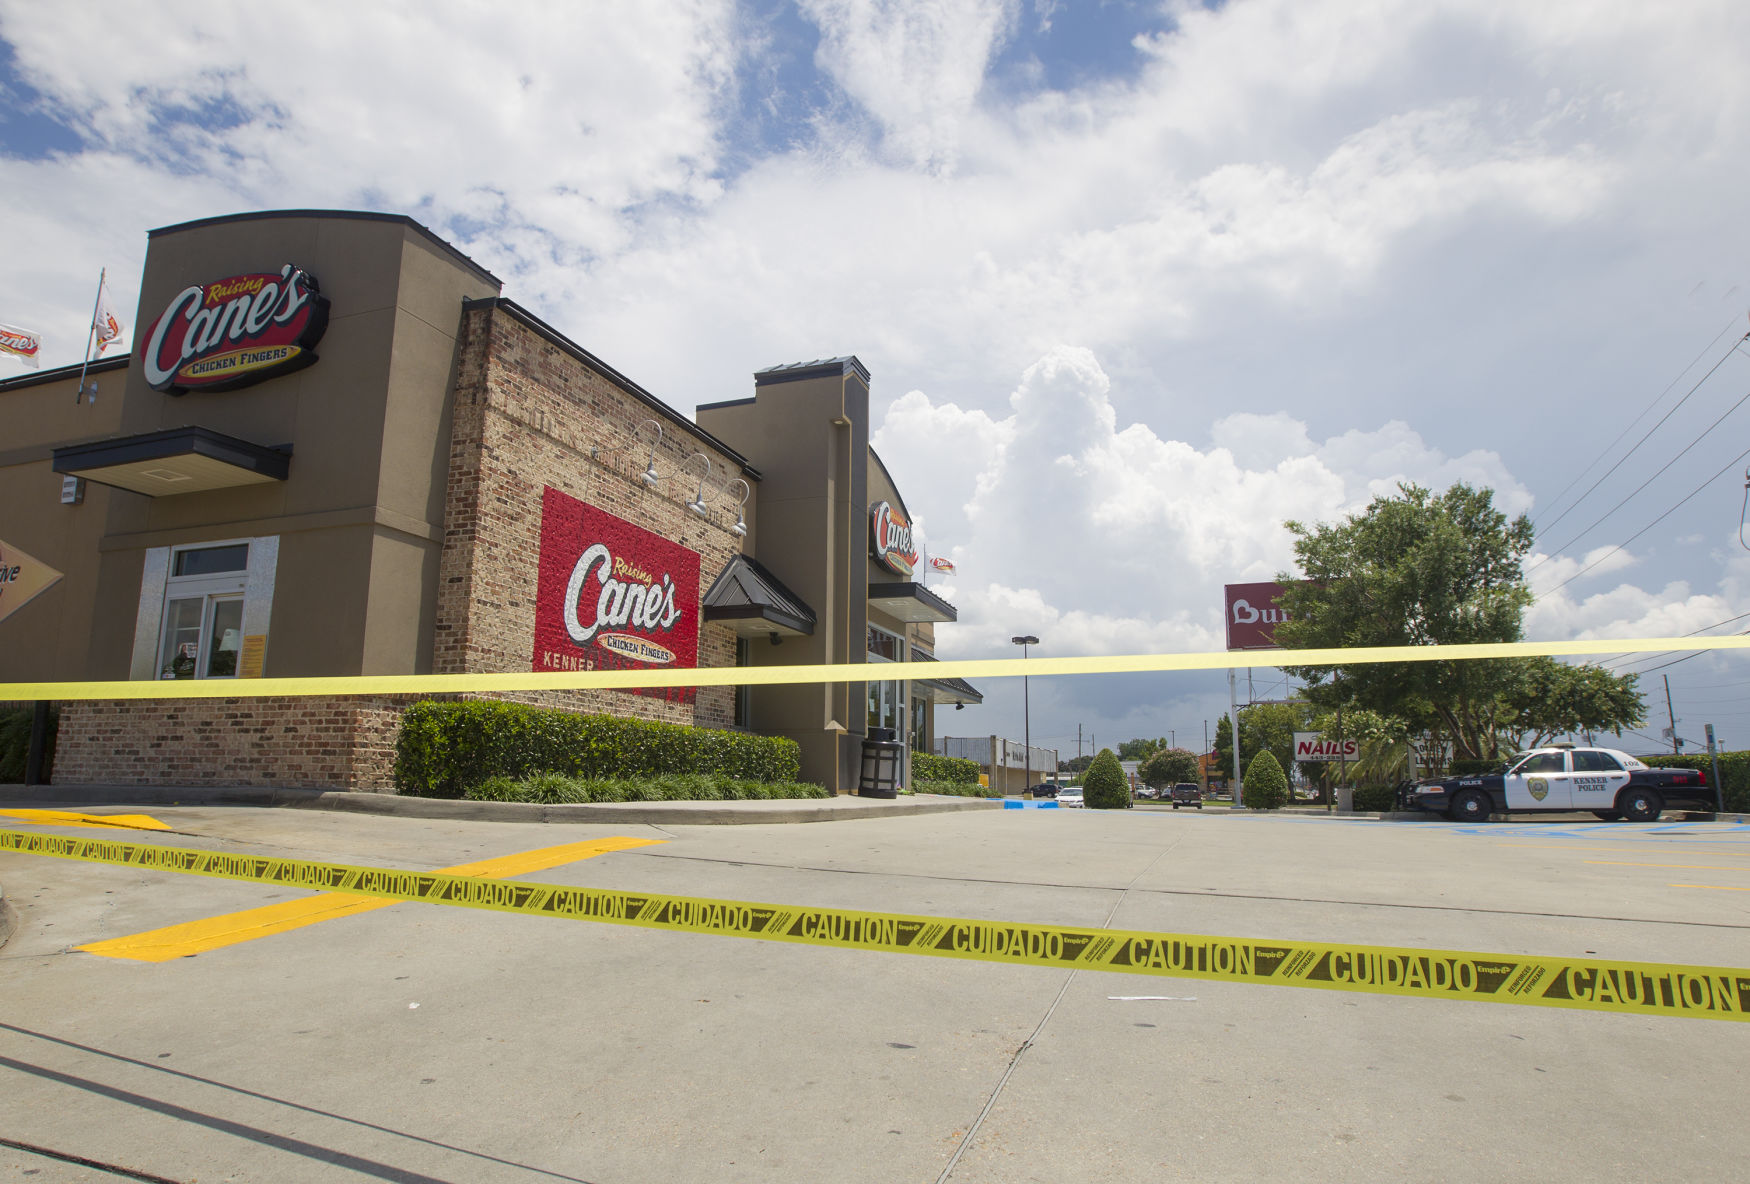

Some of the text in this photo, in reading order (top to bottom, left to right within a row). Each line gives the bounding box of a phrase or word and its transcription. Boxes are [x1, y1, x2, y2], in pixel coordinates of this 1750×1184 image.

[206, 277, 264, 304] Raising
[144, 264, 308, 385] Cane's
[192, 348, 287, 374] CHICKEN FINGERS
[613, 557, 652, 587] Raising
[564, 543, 682, 643] Cane's
[543, 651, 594, 671] KENNER
[607, 635, 669, 661] CHICKEN FINGERS
[1297, 741, 1356, 755] NAILS
[87, 842, 124, 863] CAUTION
[145, 850, 187, 870] CUIDADO
[211, 856, 256, 878] CAUTION
[281, 863, 333, 886] CUIDADO
[362, 871, 420, 897] CAUTION
[451, 879, 516, 907] CUIDADO
[553, 889, 625, 919] CAUTION
[668, 901, 753, 931] CUIDADO
[801, 912, 898, 946] CAUTION
[952, 924, 1063, 960] CUIDADO
[1129, 938, 1255, 976] CAUTION
[1329, 951, 1478, 993] CUIDADO
[1567, 966, 1742, 1013] CAUTION
